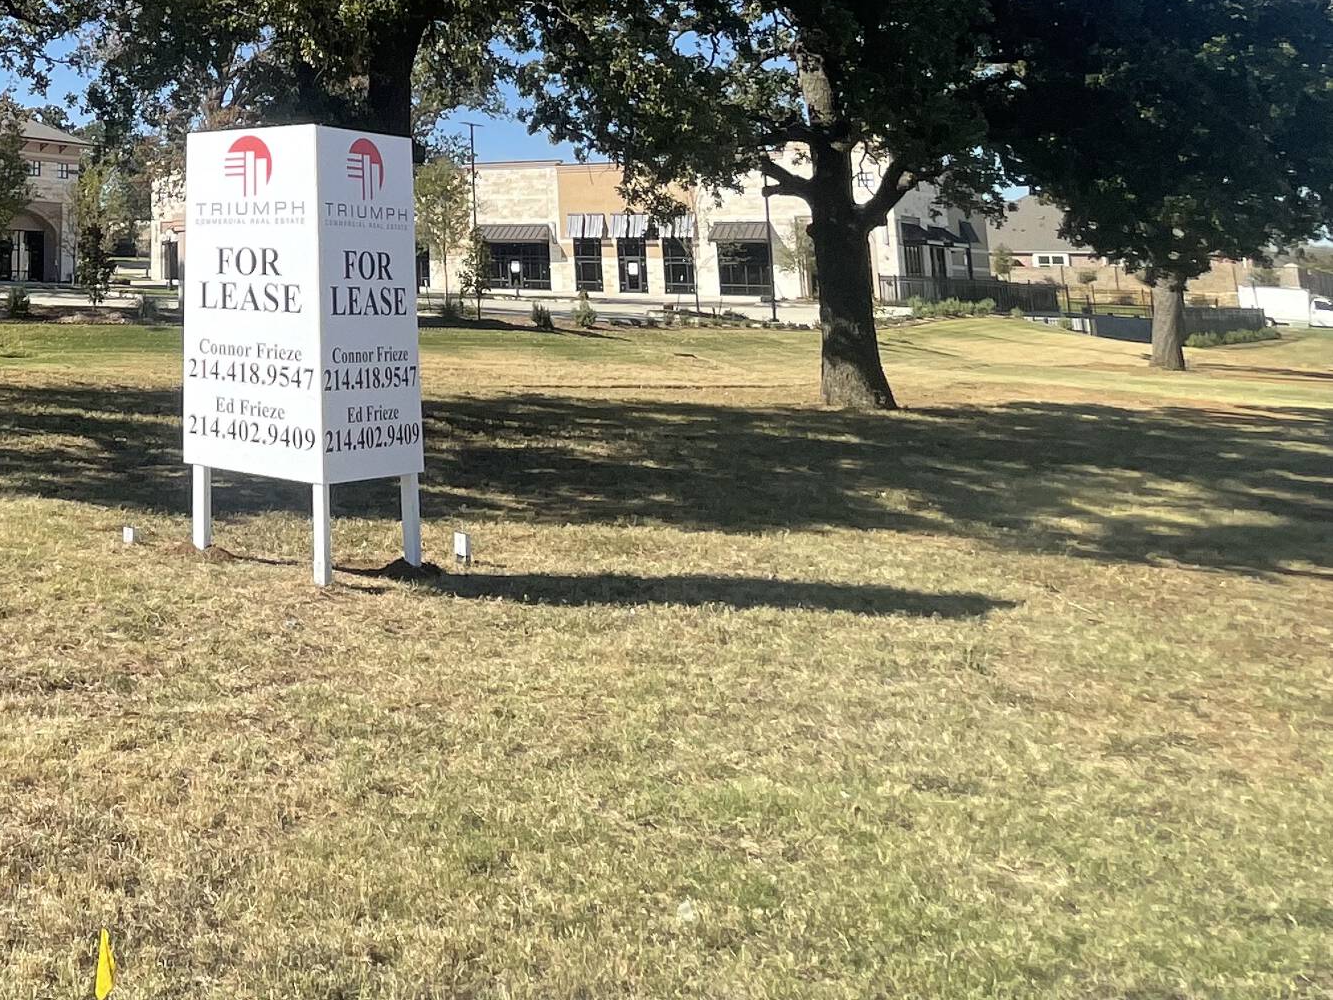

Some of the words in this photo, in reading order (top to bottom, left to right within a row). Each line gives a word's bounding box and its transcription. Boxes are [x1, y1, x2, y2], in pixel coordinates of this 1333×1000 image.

[195, 201, 305, 216] TRIUMPH
[325, 202, 408, 222] TRIUMPH
[216, 246, 282, 276] FOR
[343, 250, 393, 281] FOR
[199, 281, 303, 314] LEASE
[330, 286, 407, 316] LEASE
[199, 338, 252, 358] Connor
[256, 342, 303, 362] Frieze
[332, 347, 374, 364] Connor
[376, 346, 409, 363] Frieze
[188, 358, 315, 391] 214.418.9547
[323, 365, 417, 392] 214.418.9547
[216, 396, 235, 414] Ed
[240, 399, 285, 420] Frieze
[347, 406, 363, 424] Ed
[366, 404, 400, 422] Frieze
[188, 414, 316, 452] 214.402.9409
[325, 422, 420, 454] 214.402.9409
